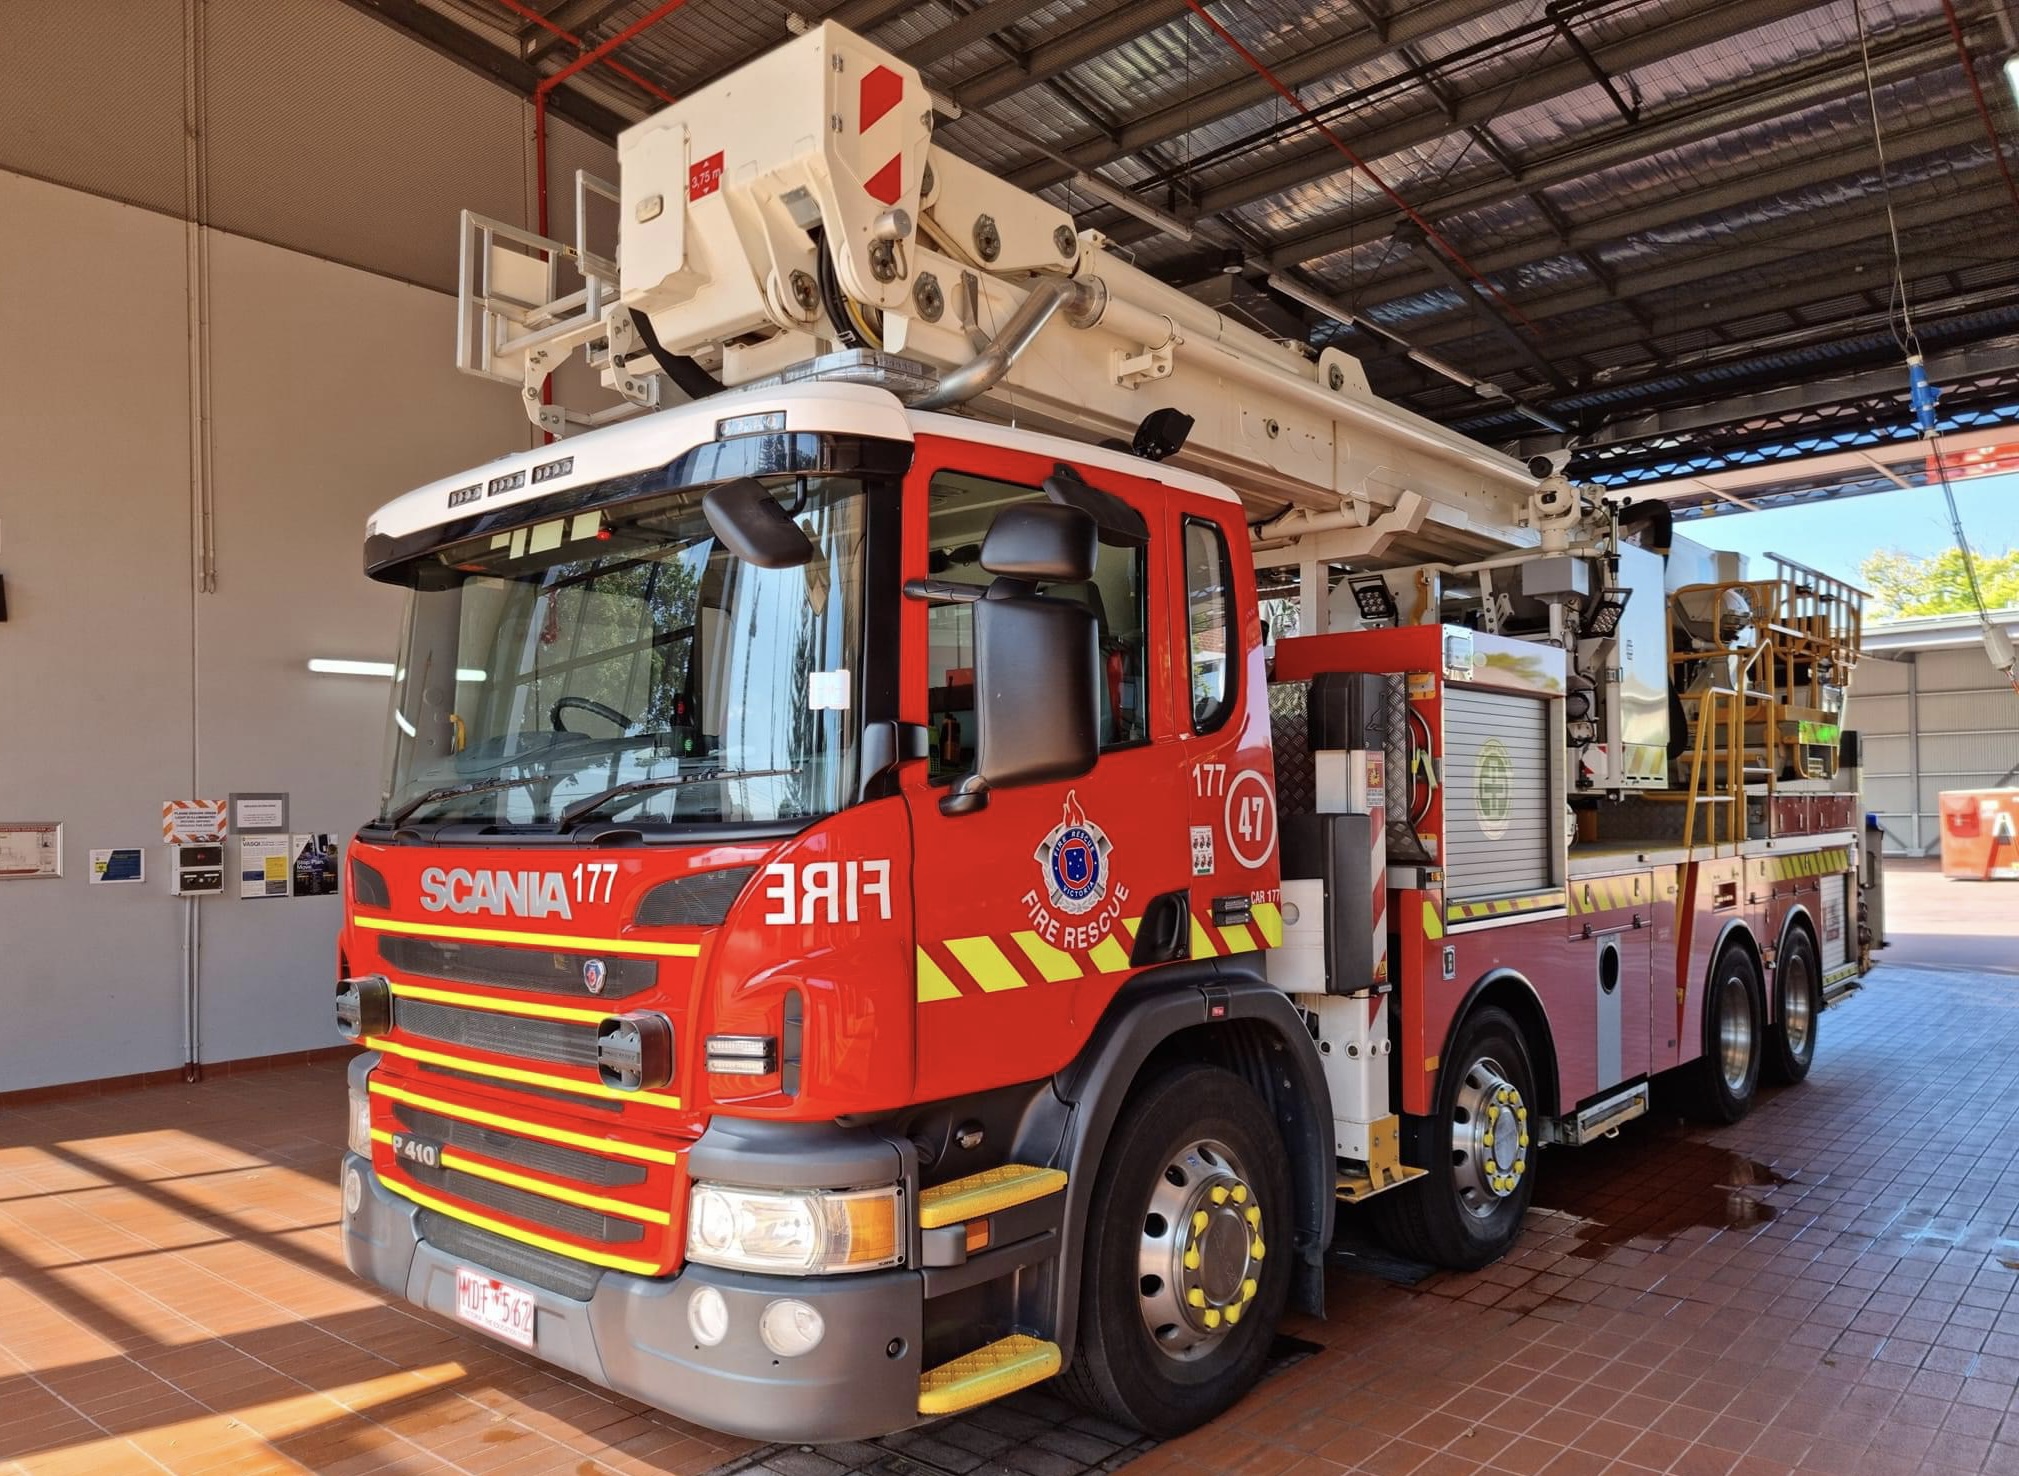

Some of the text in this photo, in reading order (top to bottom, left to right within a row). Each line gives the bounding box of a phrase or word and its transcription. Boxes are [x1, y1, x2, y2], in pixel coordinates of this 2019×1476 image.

[691, 170, 710, 189] 3,75
[1192, 763, 1226, 797] 177
[1238, 796, 1265, 842] 47
[1053, 830, 1095, 857] FIRE RESCUE
[419, 866, 573, 920] SCANIA
[572, 862, 619, 904] 177
[1063, 881, 1095, 897] VICTORIA
[1250, 888, 1280, 904] CAR 177
[1021, 882, 1130, 949] FIRE RESCUE
[393, 1134, 435, 1166] P 410
